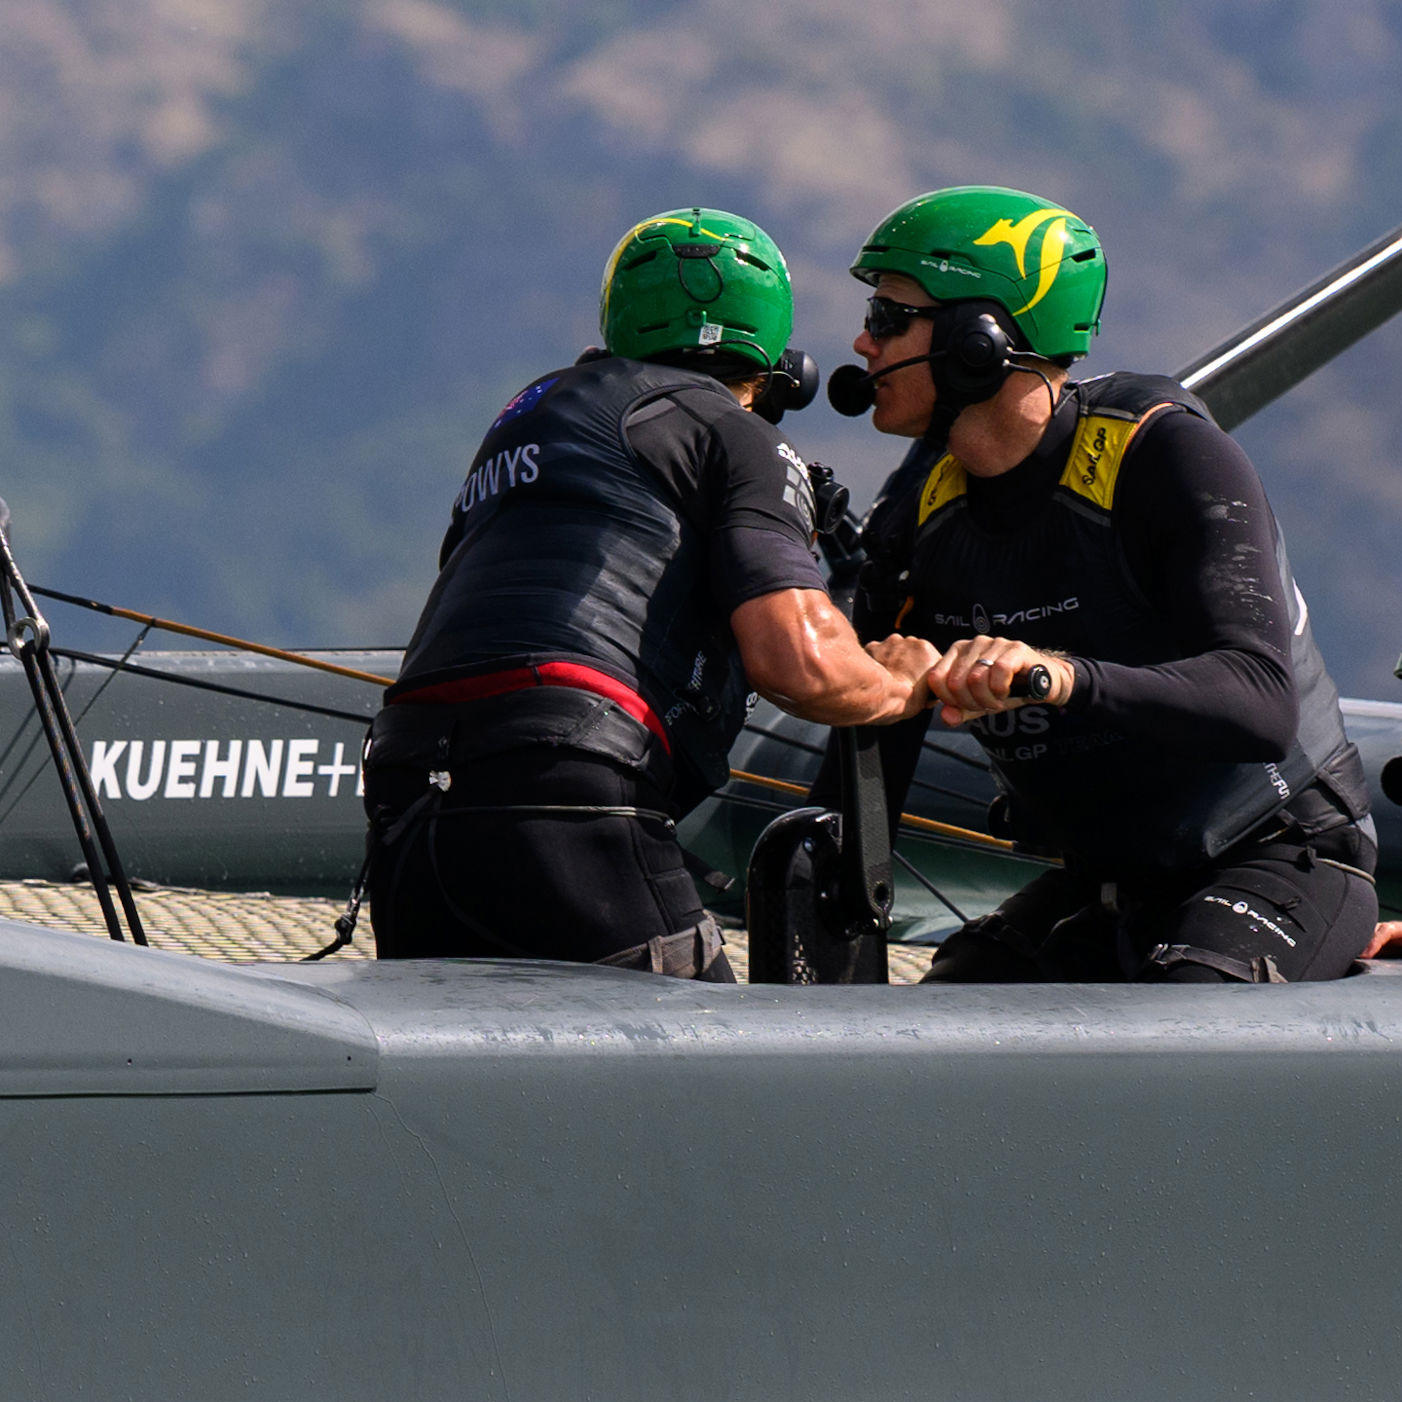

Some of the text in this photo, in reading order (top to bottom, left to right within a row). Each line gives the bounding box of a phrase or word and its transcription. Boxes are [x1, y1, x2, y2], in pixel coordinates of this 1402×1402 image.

[1082, 453, 1101, 486] SAIL
[933, 597, 1081, 628] SAIL RACING
[90, 739, 365, 801] KUEHNE+
